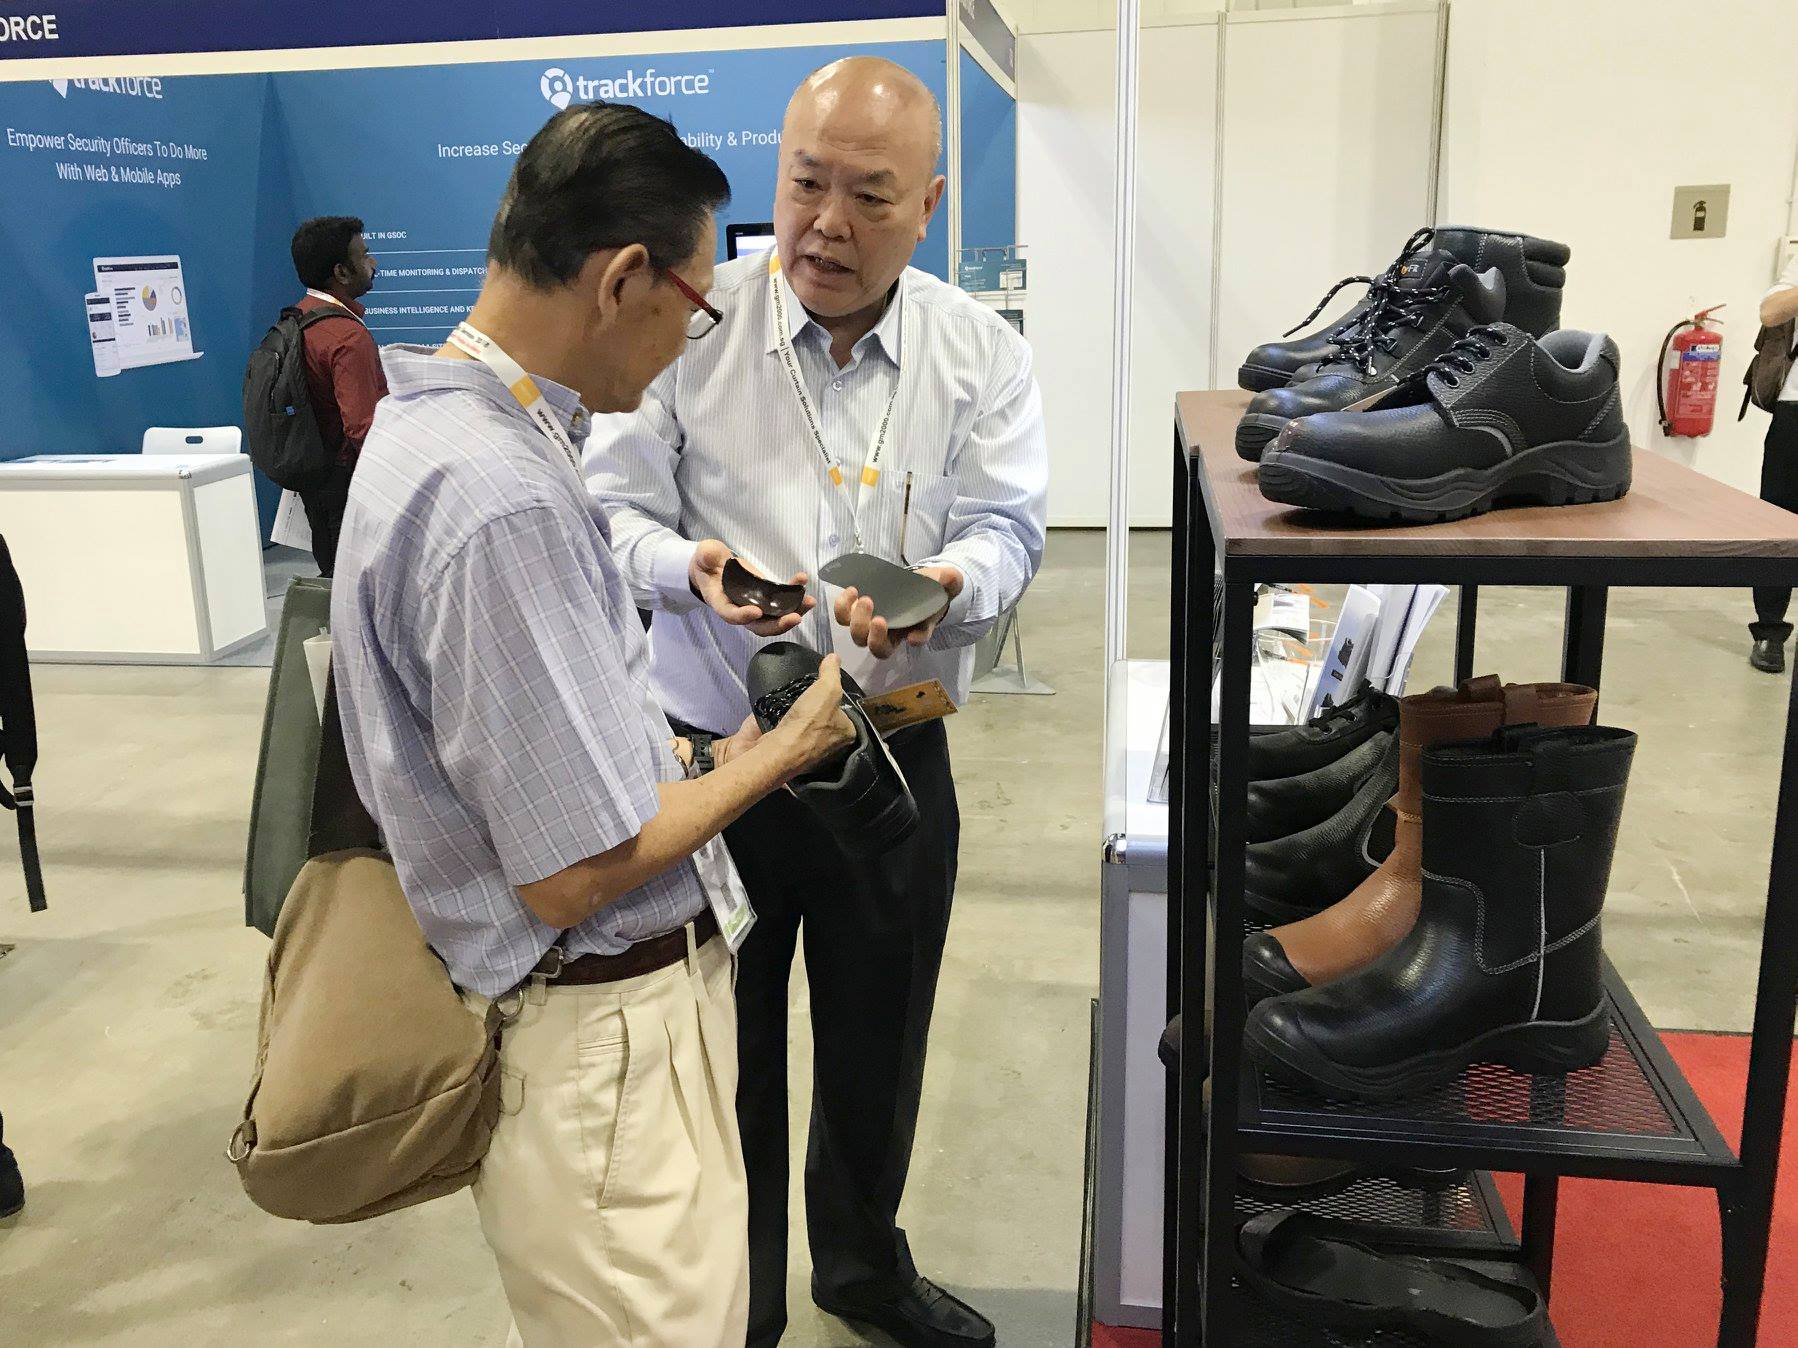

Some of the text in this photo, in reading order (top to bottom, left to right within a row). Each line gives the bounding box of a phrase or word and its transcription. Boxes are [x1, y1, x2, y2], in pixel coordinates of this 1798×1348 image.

[0, 15, 59, 42] ORCE
[577, 68, 709, 100] trackforce
[6, 128, 208, 160] Empower Security Officers To Do More
[438, 129, 784, 158] Increase Sec ability & Produ
[56, 162, 181, 188] With Web & Mobile Apps
[361, 232, 377, 240] UILT
[398, 267, 444, 277] MONITORING
[445, 268, 451, 276] &
[365, 307, 398, 315] BUSINESS
[399, 306, 449, 314] INTELLIGENCE
[450, 305, 465, 313] AND
[783, 351, 793, 369] Your
[789, 368, 803, 396] Curtain
[800, 396, 816, 430] Solutions
[813, 430, 831, 464] Specialist
